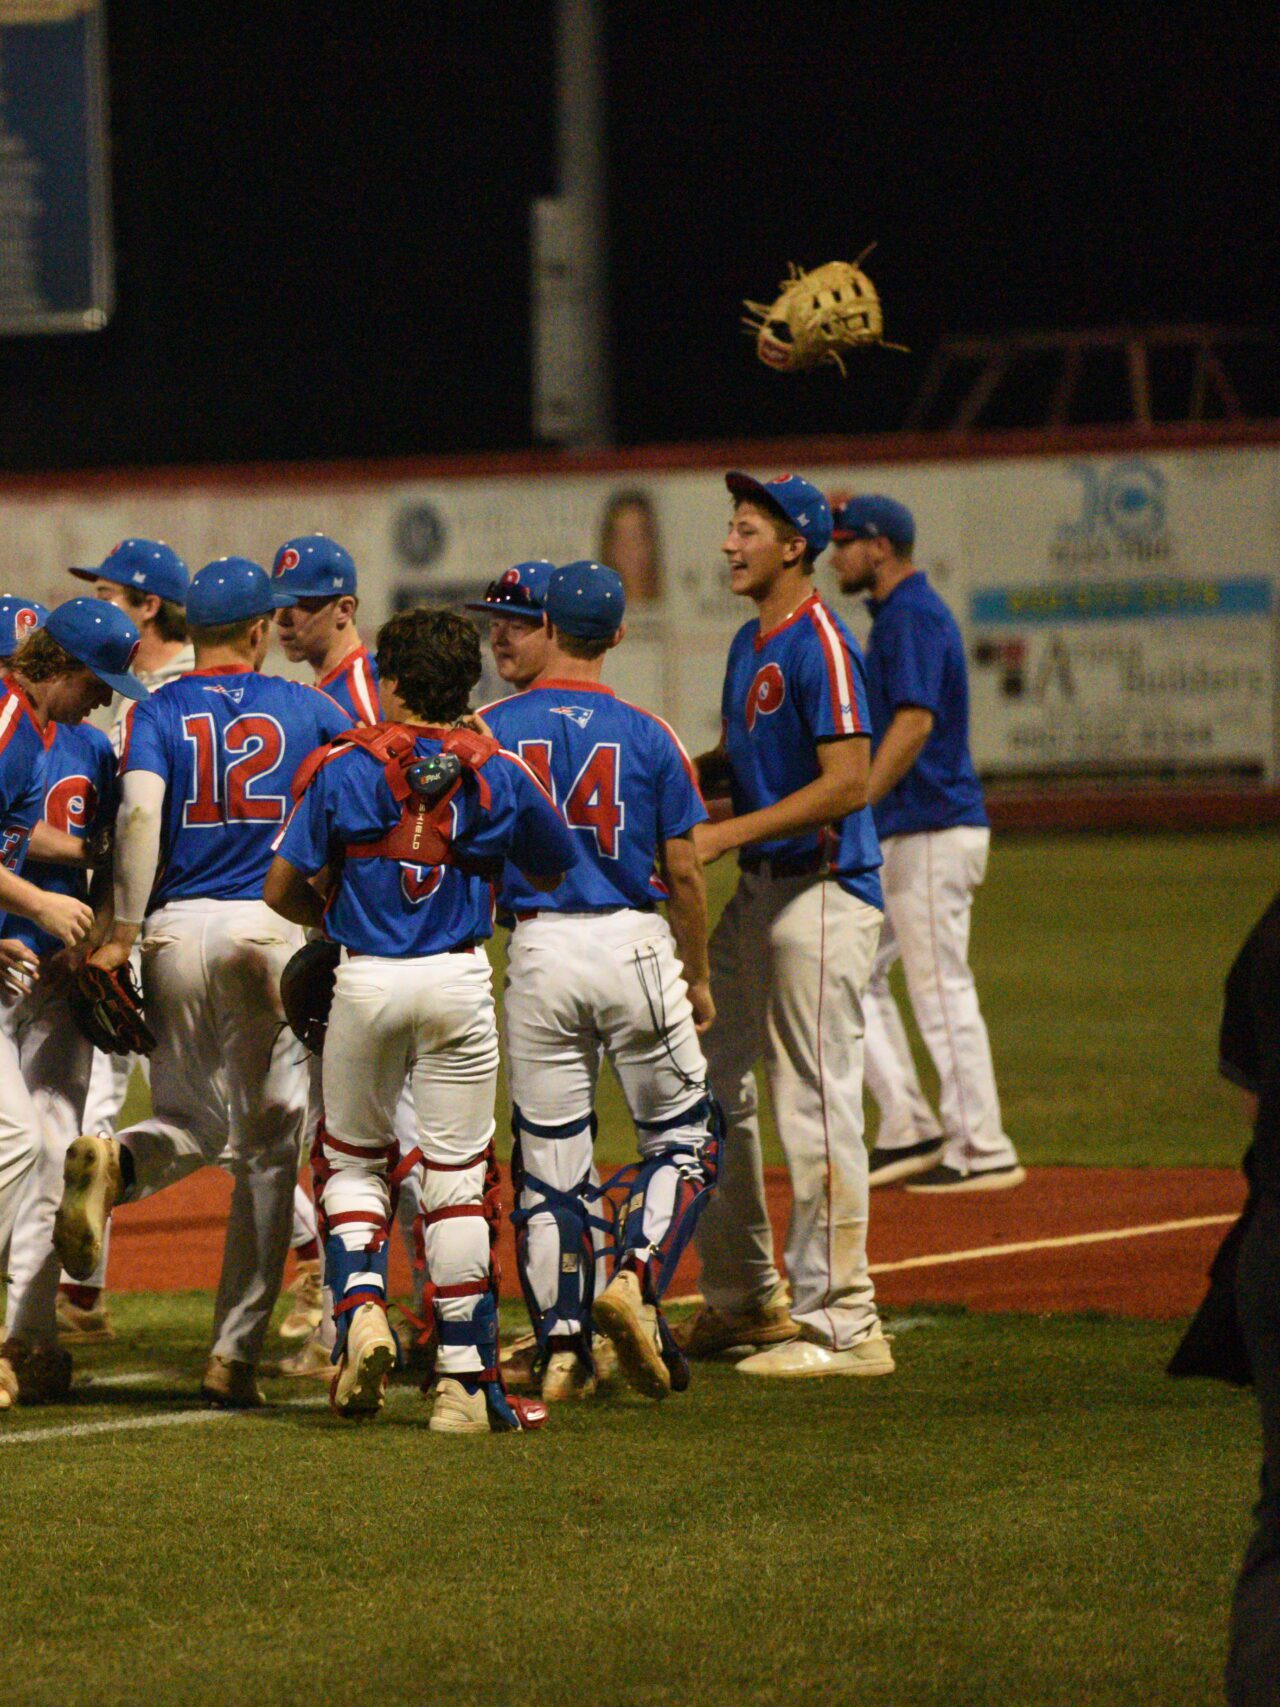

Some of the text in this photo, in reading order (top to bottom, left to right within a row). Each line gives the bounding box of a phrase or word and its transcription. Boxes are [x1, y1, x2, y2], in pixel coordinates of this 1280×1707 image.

[275, 548, 300, 578] P
[15, 607, 38, 640] P
[746, 662, 786, 732] P
[183, 712, 286, 828] 12
[518, 740, 624, 859] 14
[44, 774, 100, 835] P
